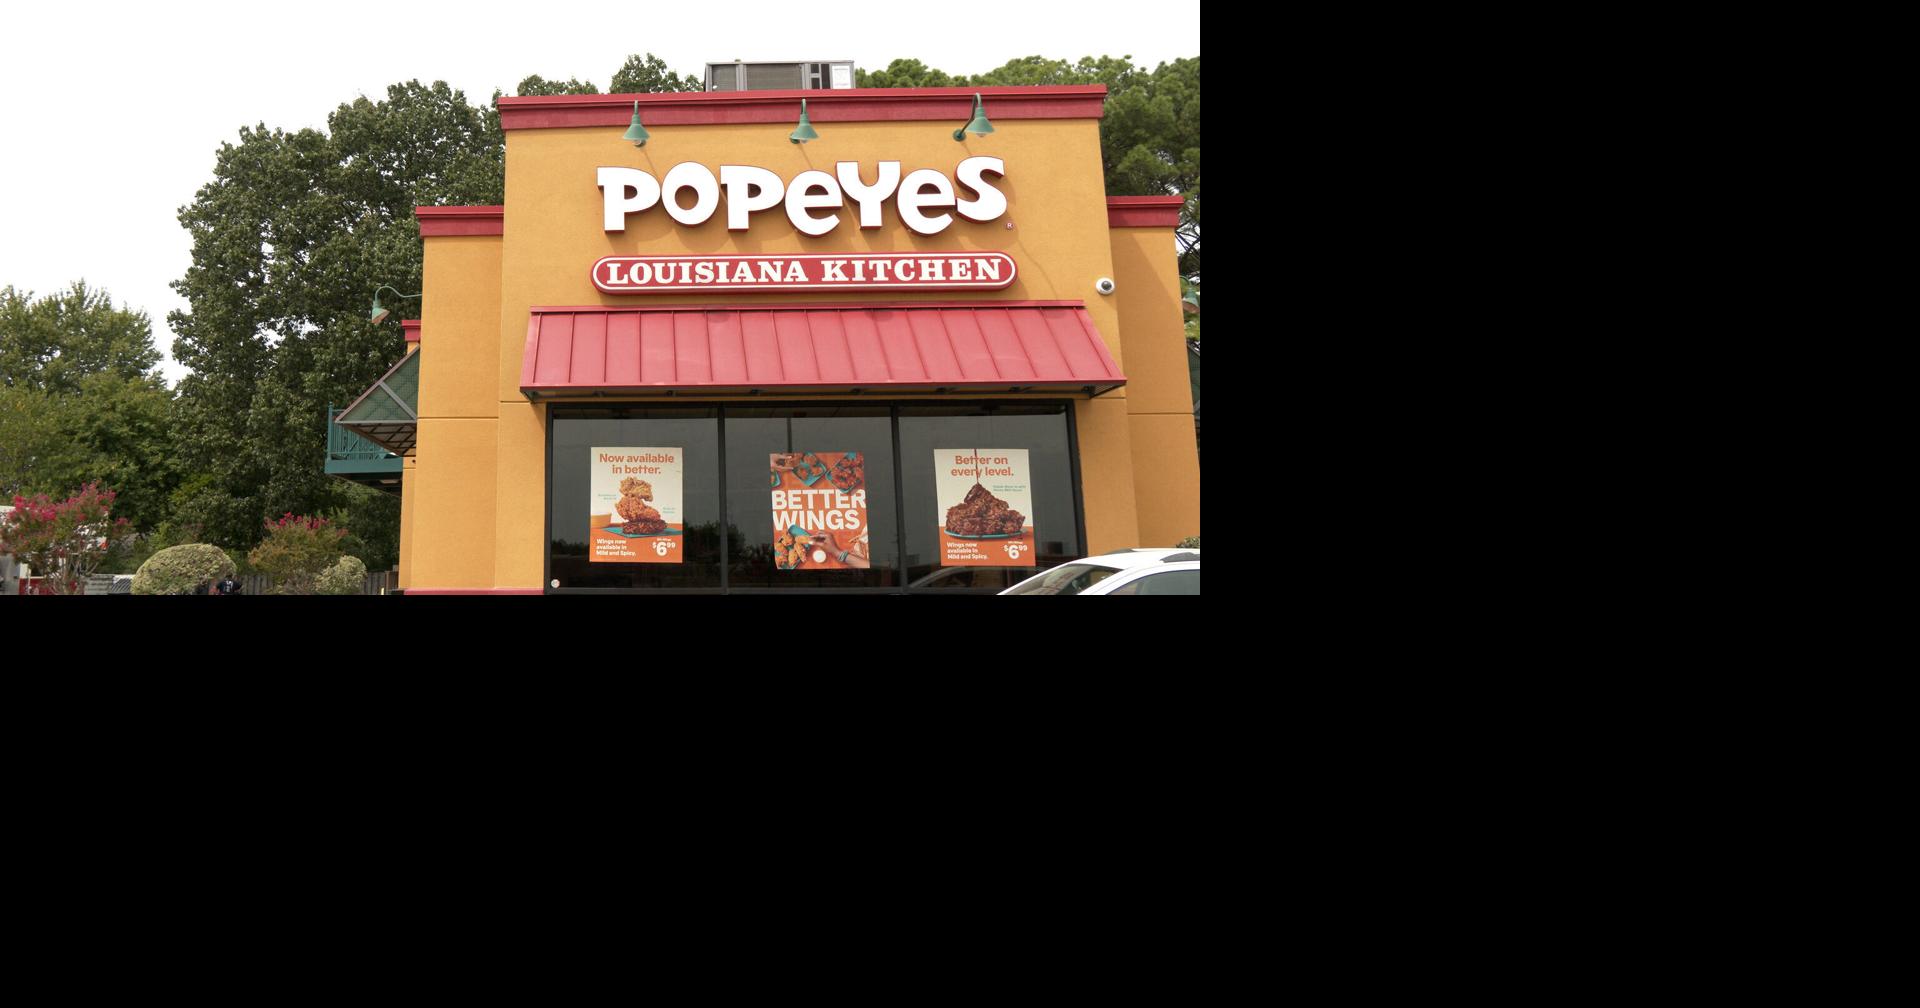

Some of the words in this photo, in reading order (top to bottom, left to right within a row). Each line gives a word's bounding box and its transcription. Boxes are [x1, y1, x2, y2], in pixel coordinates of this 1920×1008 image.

[606, 260, 809, 286] LOUISIANA
[821, 258, 1002, 283] KITCHEN
[599, 453, 624, 463] Now
[627, 453, 675, 463] available
[955, 456, 991, 465] Better
[994, 456, 1008, 465] on
[612, 464, 622, 474] in
[624, 464, 661, 474] better.
[951, 467, 982, 478] every
[985, 467, 1014, 476] level.
[771, 489, 866, 509] BETTER
[772, 510, 860, 530] WINGS
